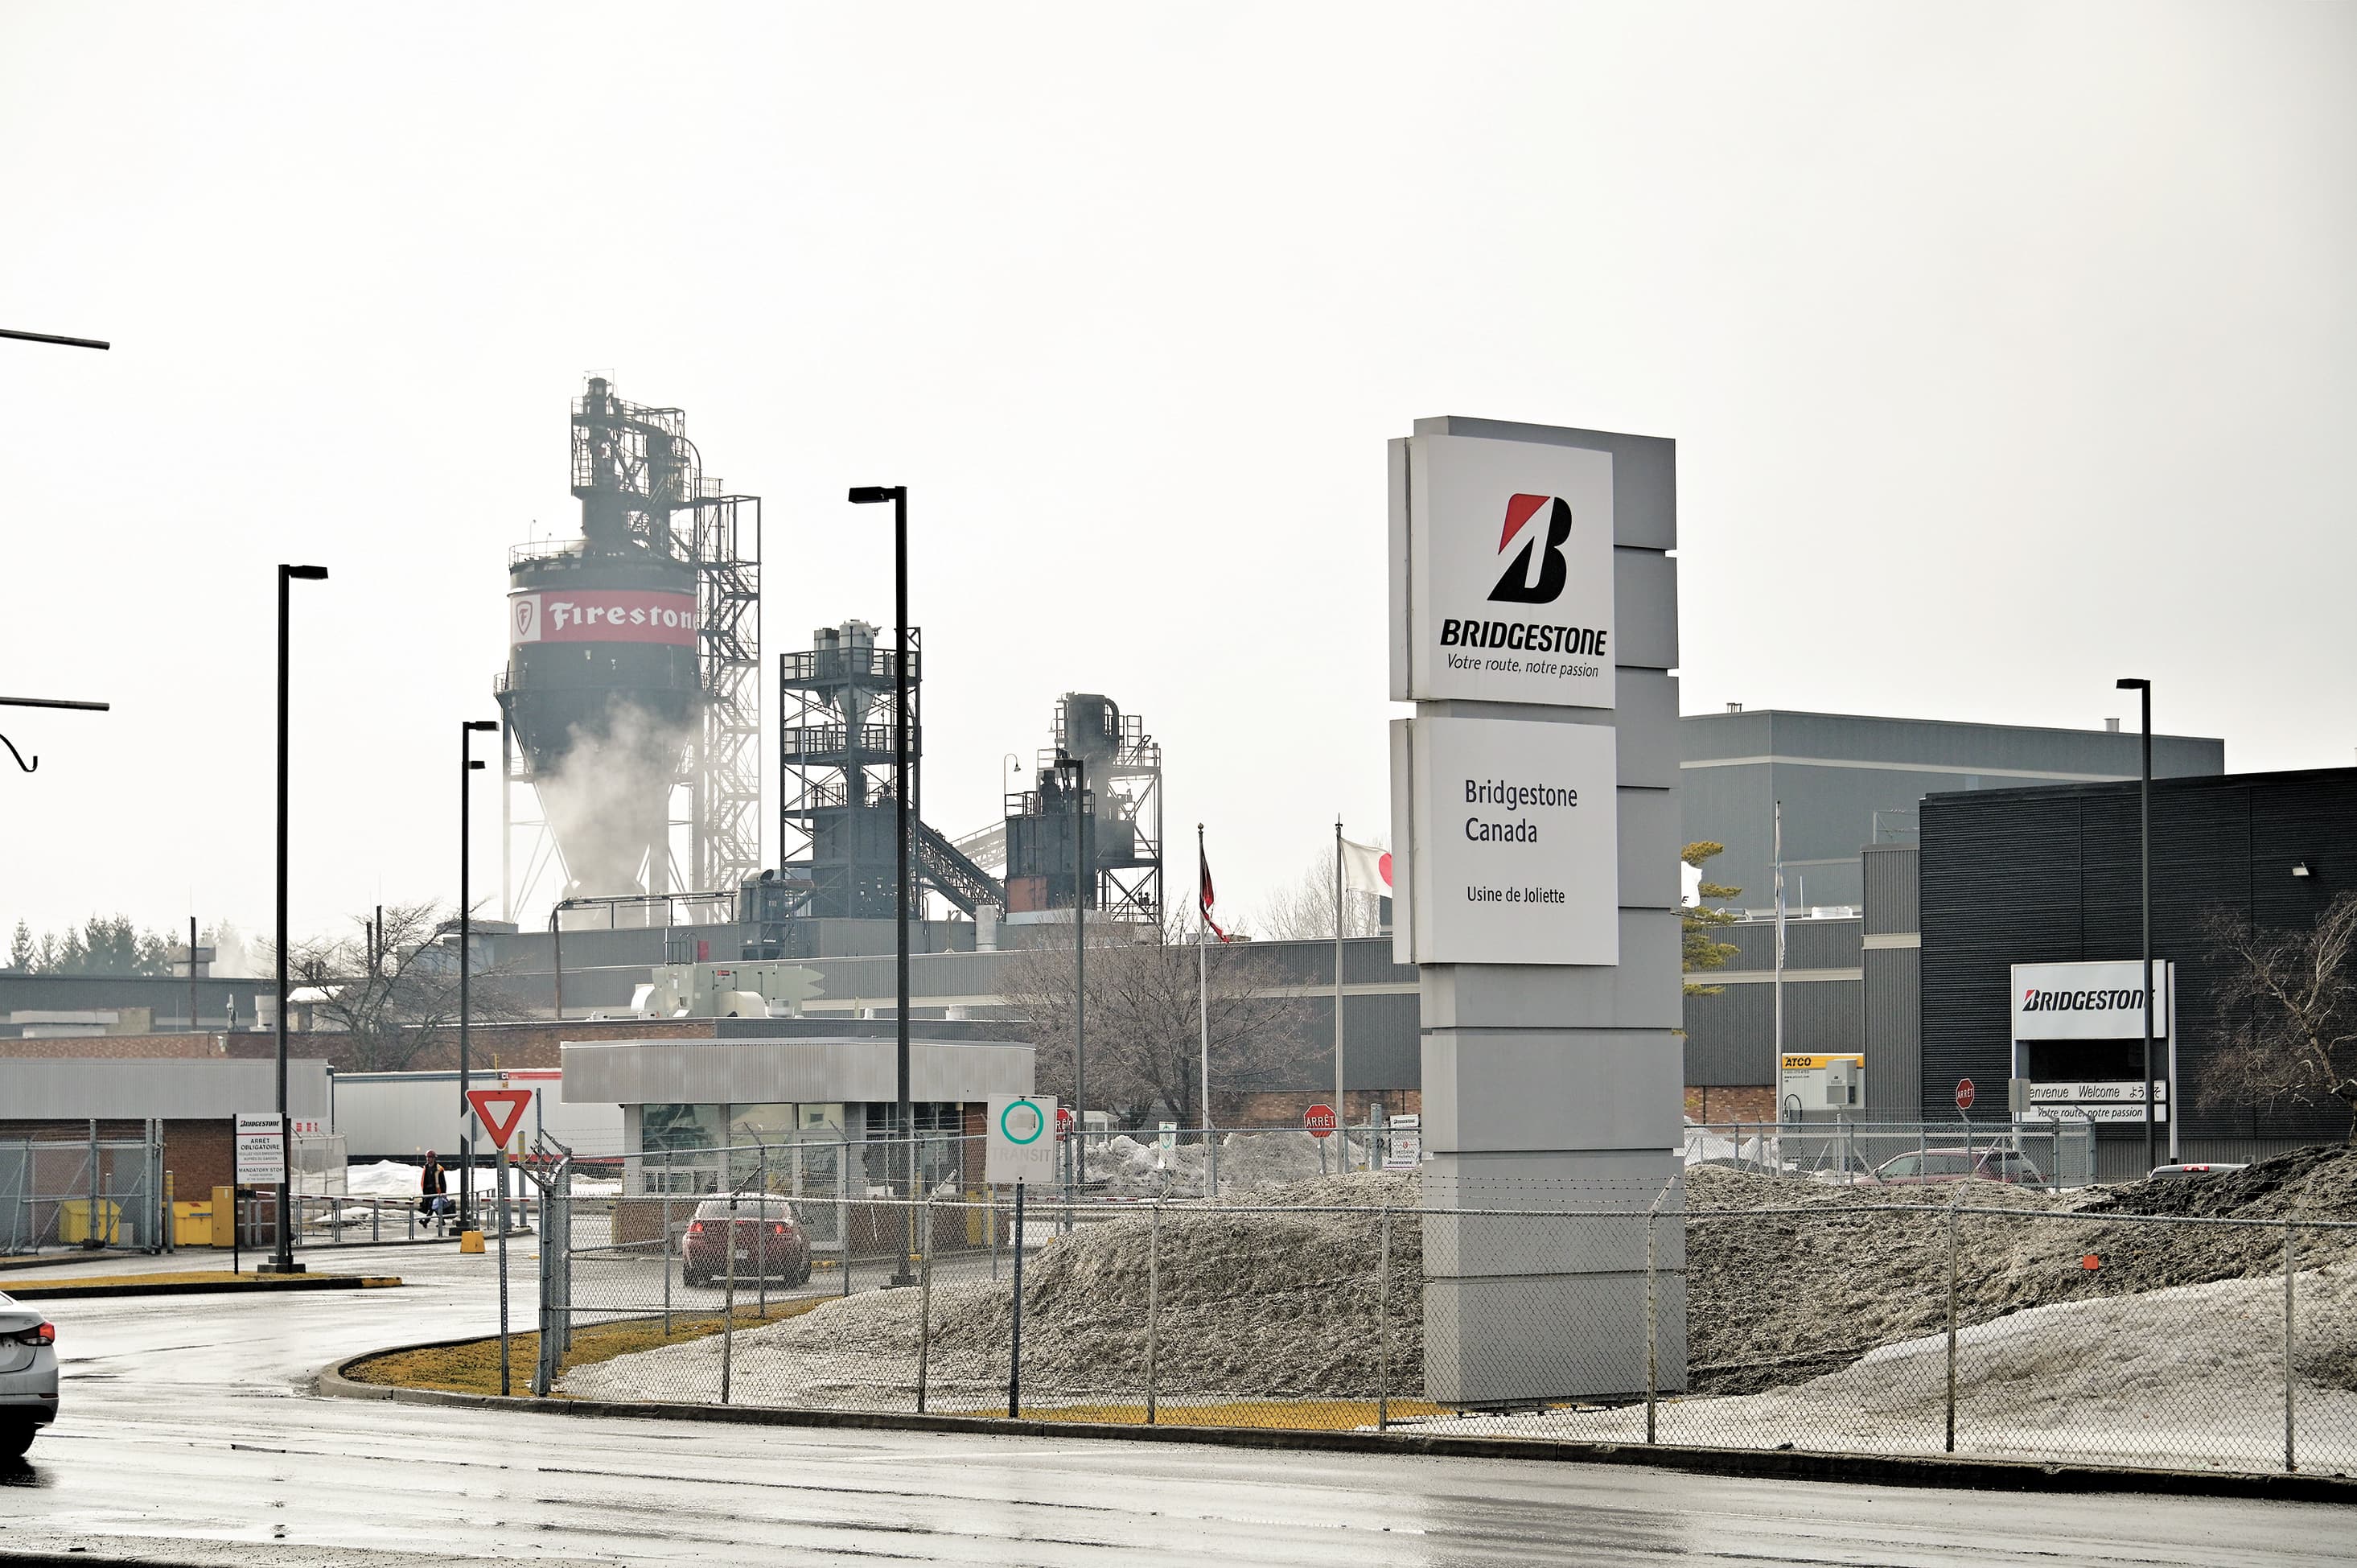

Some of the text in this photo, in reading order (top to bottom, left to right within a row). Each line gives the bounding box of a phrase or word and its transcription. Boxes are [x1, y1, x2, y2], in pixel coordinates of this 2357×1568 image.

[1440, 618, 1607, 656] BRIDGESTONE
[1447, 652, 1599, 678] Votre route, notre passion
[1465, 779, 1578, 811] Bridgestone
[1465, 817, 1538, 843] Canada
[1466, 886, 1565, 903] Usine de Joliette
[1785, 1057, 1812, 1067] ATCO
[1957, 1087, 1973, 1099] ARRÊT
[2030, 1085, 2162, 1098] envenue Welcome ようそ
[1306, 1113, 1335, 1127] ARRÊT
[2038, 1108, 2059, 1117] Votre
[2088, 1109, 2110, 1117] notre
[2112, 1107, 2143, 1119] passion
[992, 1146, 1051, 1163] TRANSIT
